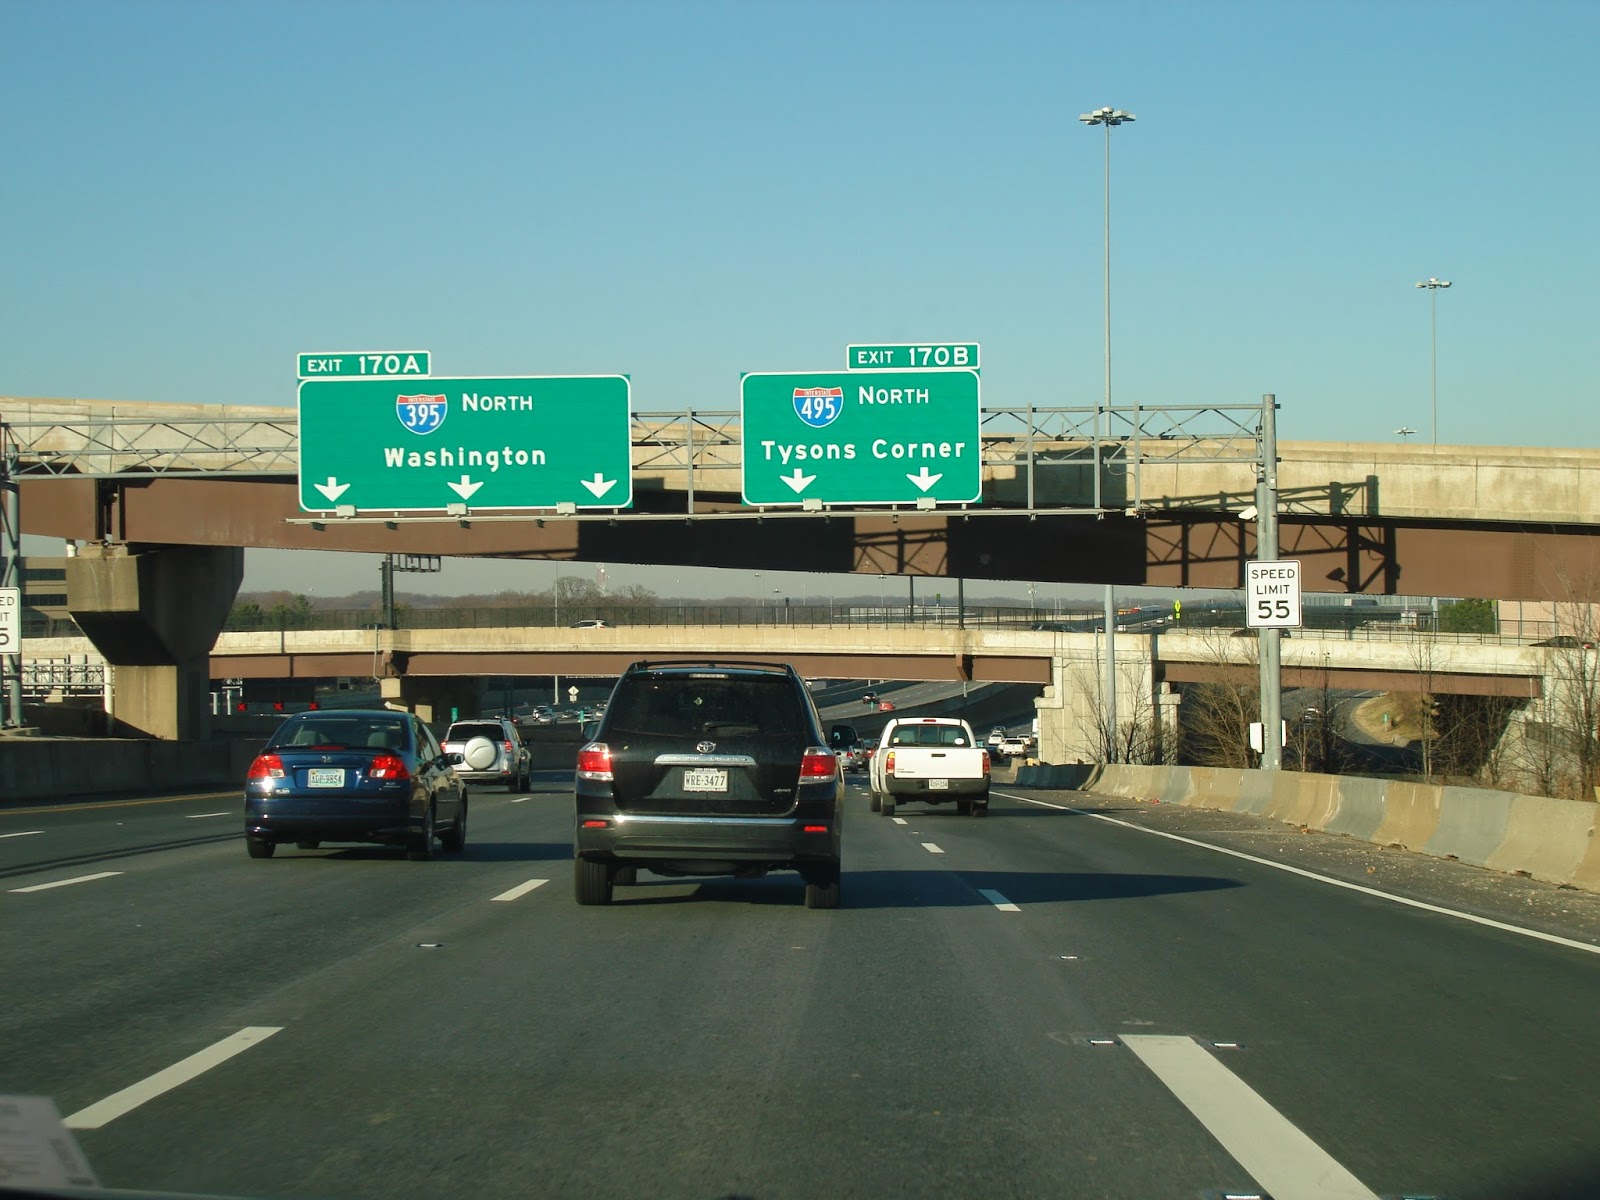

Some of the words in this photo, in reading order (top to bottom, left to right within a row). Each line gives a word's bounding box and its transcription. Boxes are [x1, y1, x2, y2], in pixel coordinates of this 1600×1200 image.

[307, 359, 343, 373] EXIT
[358, 354, 421, 375] 170A
[856, 350, 894, 365] EXIT
[908, 346, 969, 366] 170B
[461, 392, 533, 412] NORTH
[858, 385, 929, 405] NORTH
[406, 404, 440, 427] 395
[800, 397, 836, 420] 495
[383, 446, 546, 473] Washington
[760, 440, 857, 465] Tysons
[871, 438, 966, 459] Corner
[1251, 568, 1295, 580] SPEED
[1256, 584, 1290, 595] LIMIT
[1258, 599, 1290, 619] 55
[685, 774, 726, 787] WRE-3477
